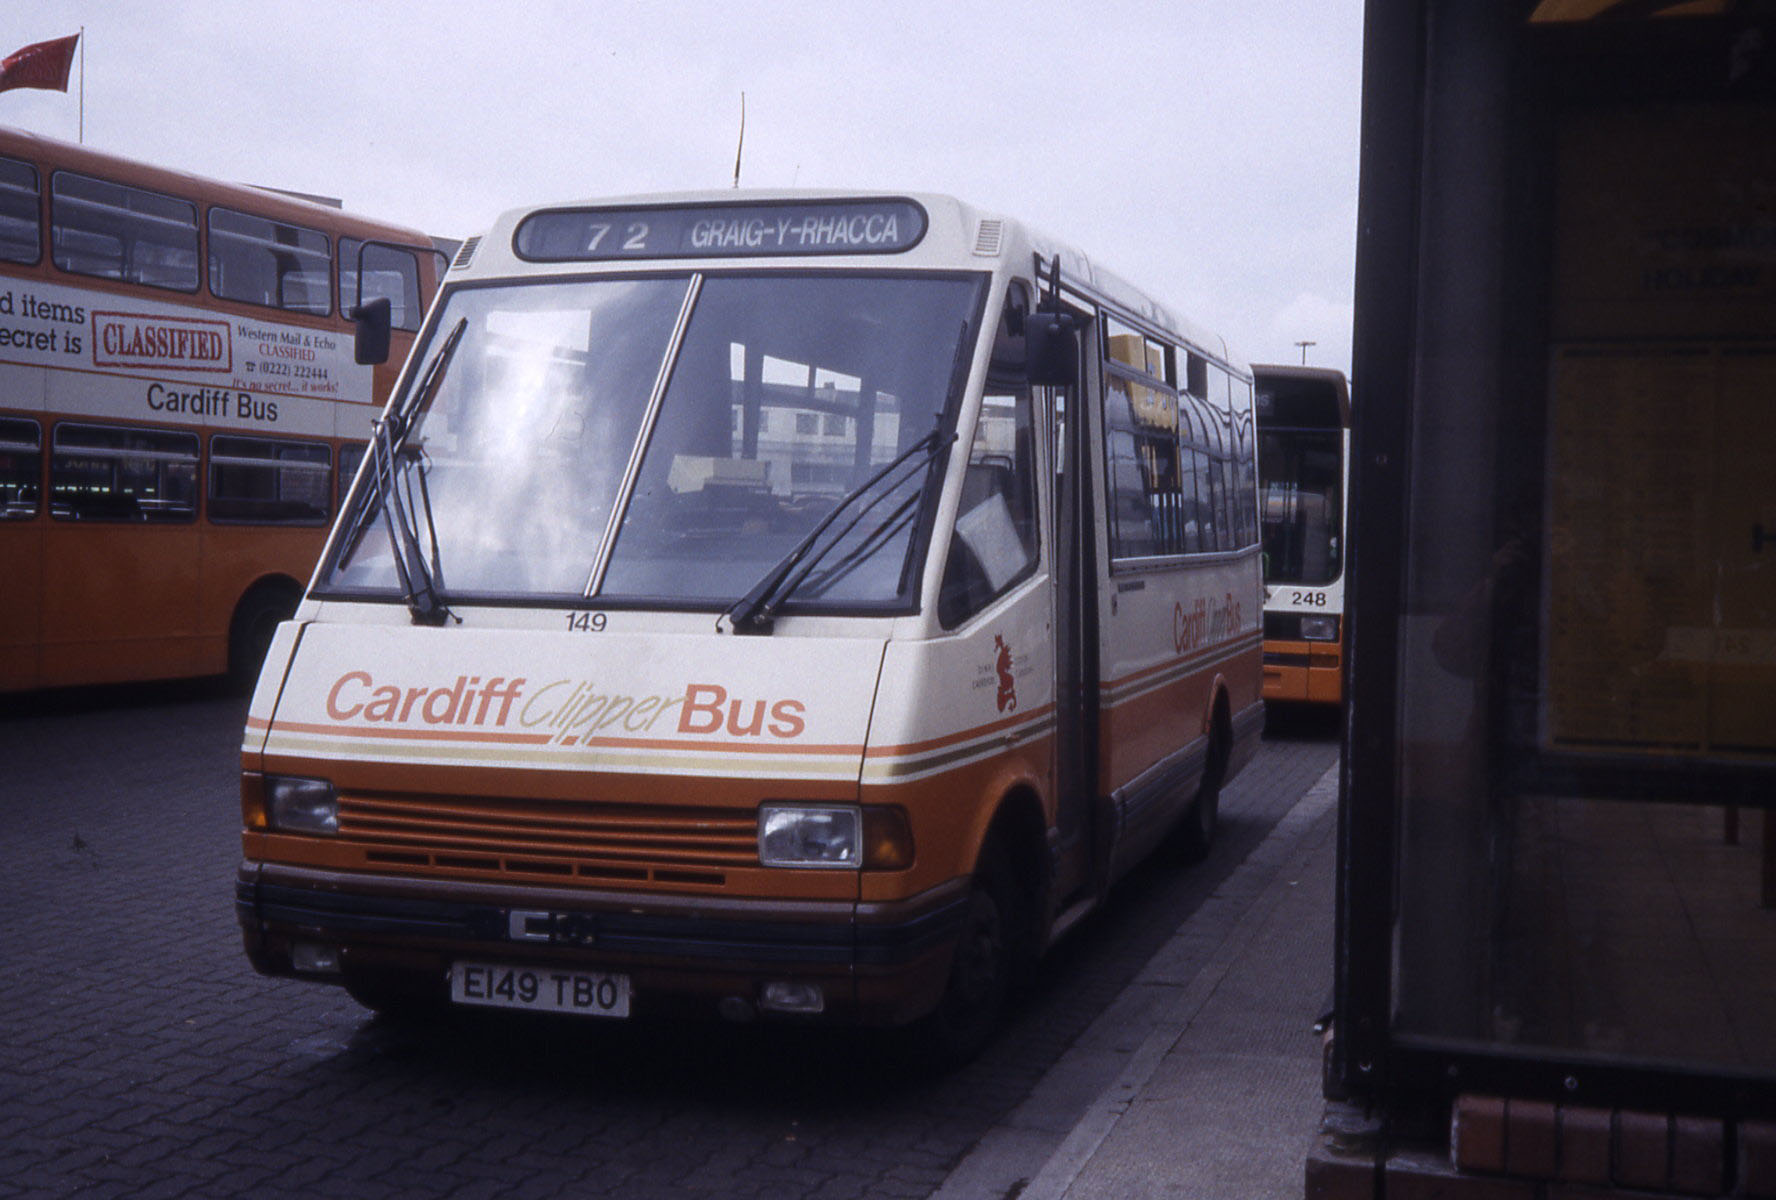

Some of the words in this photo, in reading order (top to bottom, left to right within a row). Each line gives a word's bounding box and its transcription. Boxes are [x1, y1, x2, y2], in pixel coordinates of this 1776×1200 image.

[690, 213, 899, 249] GRAIG-Y-RHACCA
[21, 294, 85, 324] items
[63, 330, 82, 354] is
[102, 322, 223, 362] CLASSIFIED
[237, 324, 278, 341] Western
[280, 331, 302, 346] Mail
[303, 335, 312, 347] &
[313, 336, 336, 351] Echo
[258, 343, 316, 361] CLASSIFIED
[259, 361, 291, 377] (0222)
[293, 365, 329, 380] 222444
[147, 383, 230, 418] Cardiff
[237, 392, 279, 422] Bus
[1291, 591, 1327, 607] 248
[566, 611, 608, 632] 149
[326, 670, 527, 726] Cardiff
[519, 679, 688, 745] Clipper
[677, 683, 806, 739] Bus
[463, 967, 539, 1004] E149
[551, 975, 618, 1010] TBO
